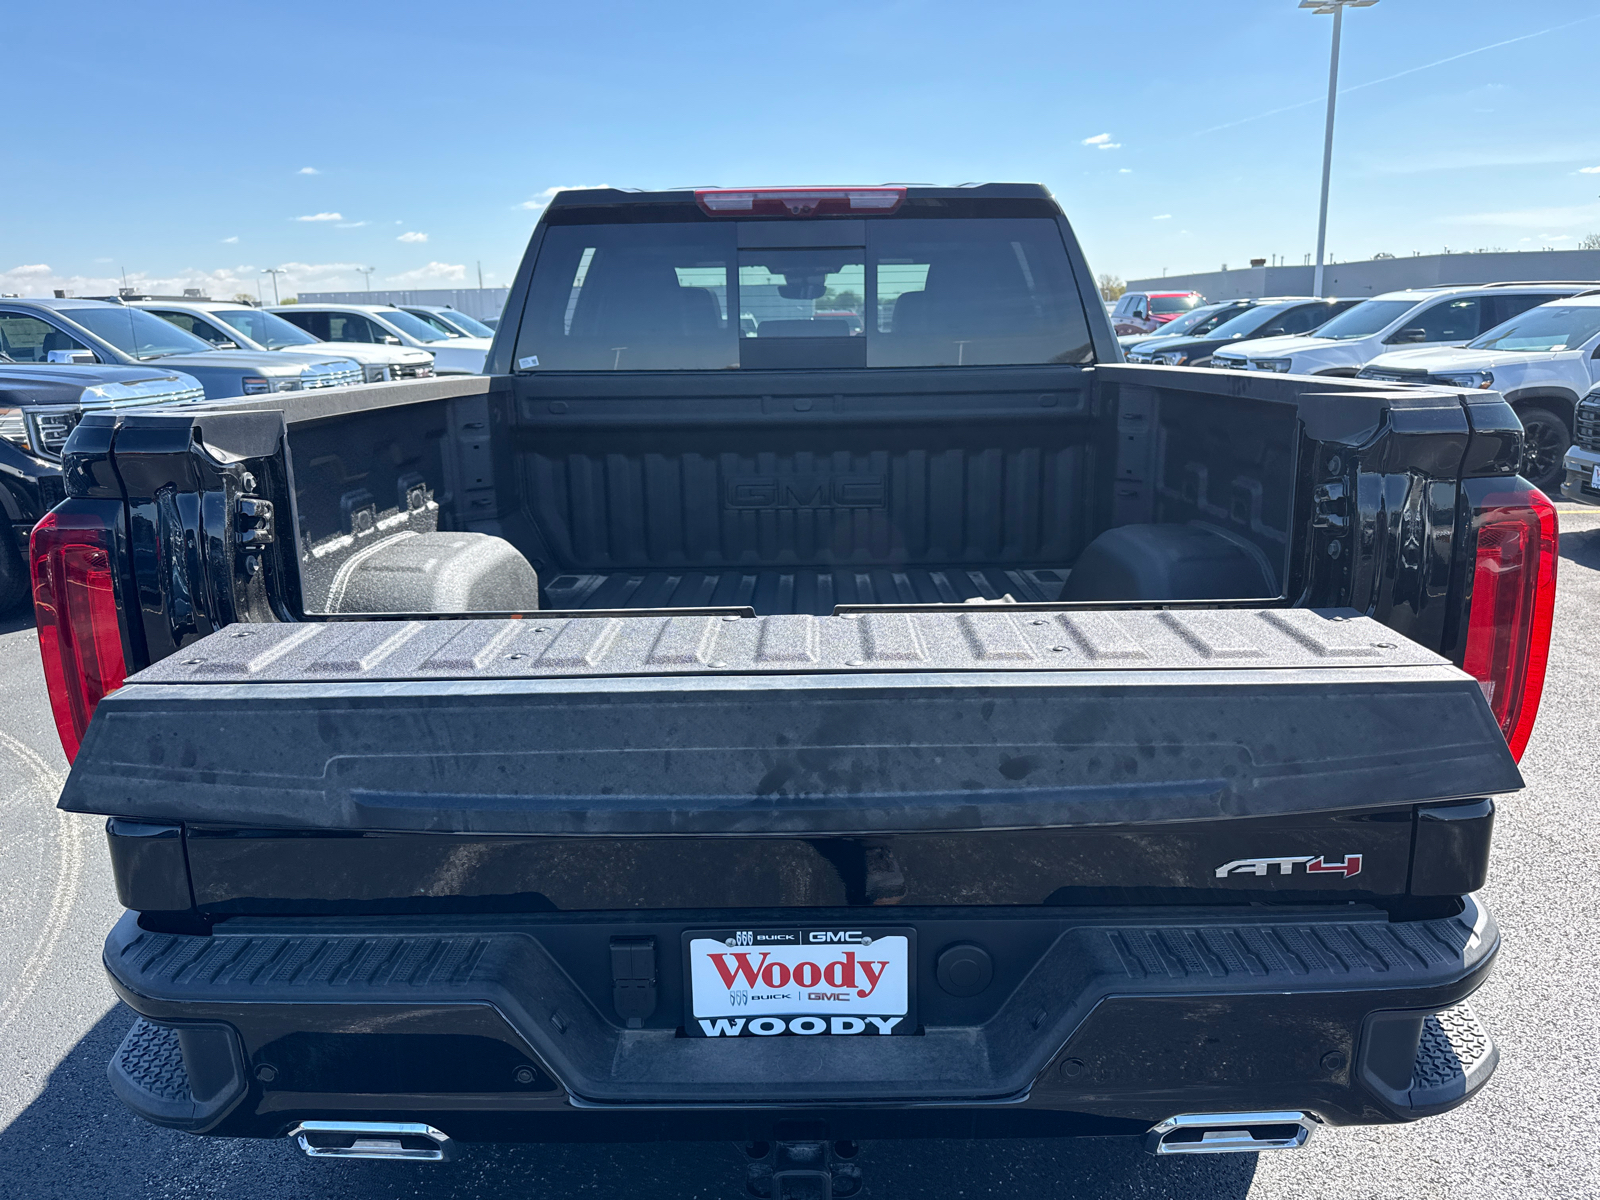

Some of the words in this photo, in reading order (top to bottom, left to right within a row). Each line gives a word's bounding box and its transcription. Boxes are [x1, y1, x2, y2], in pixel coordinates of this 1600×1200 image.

[726, 476, 887, 509] GMC
[1215, 853, 1363, 879] AT4
[756, 933, 795, 941] BUICK
[809, 931, 862, 942] GMC
[707, 951, 890, 998] Woody
[751, 993, 792, 1001] BUICK
[808, 992, 850, 1002] GMC
[698, 1017, 903, 1037] WOODY
